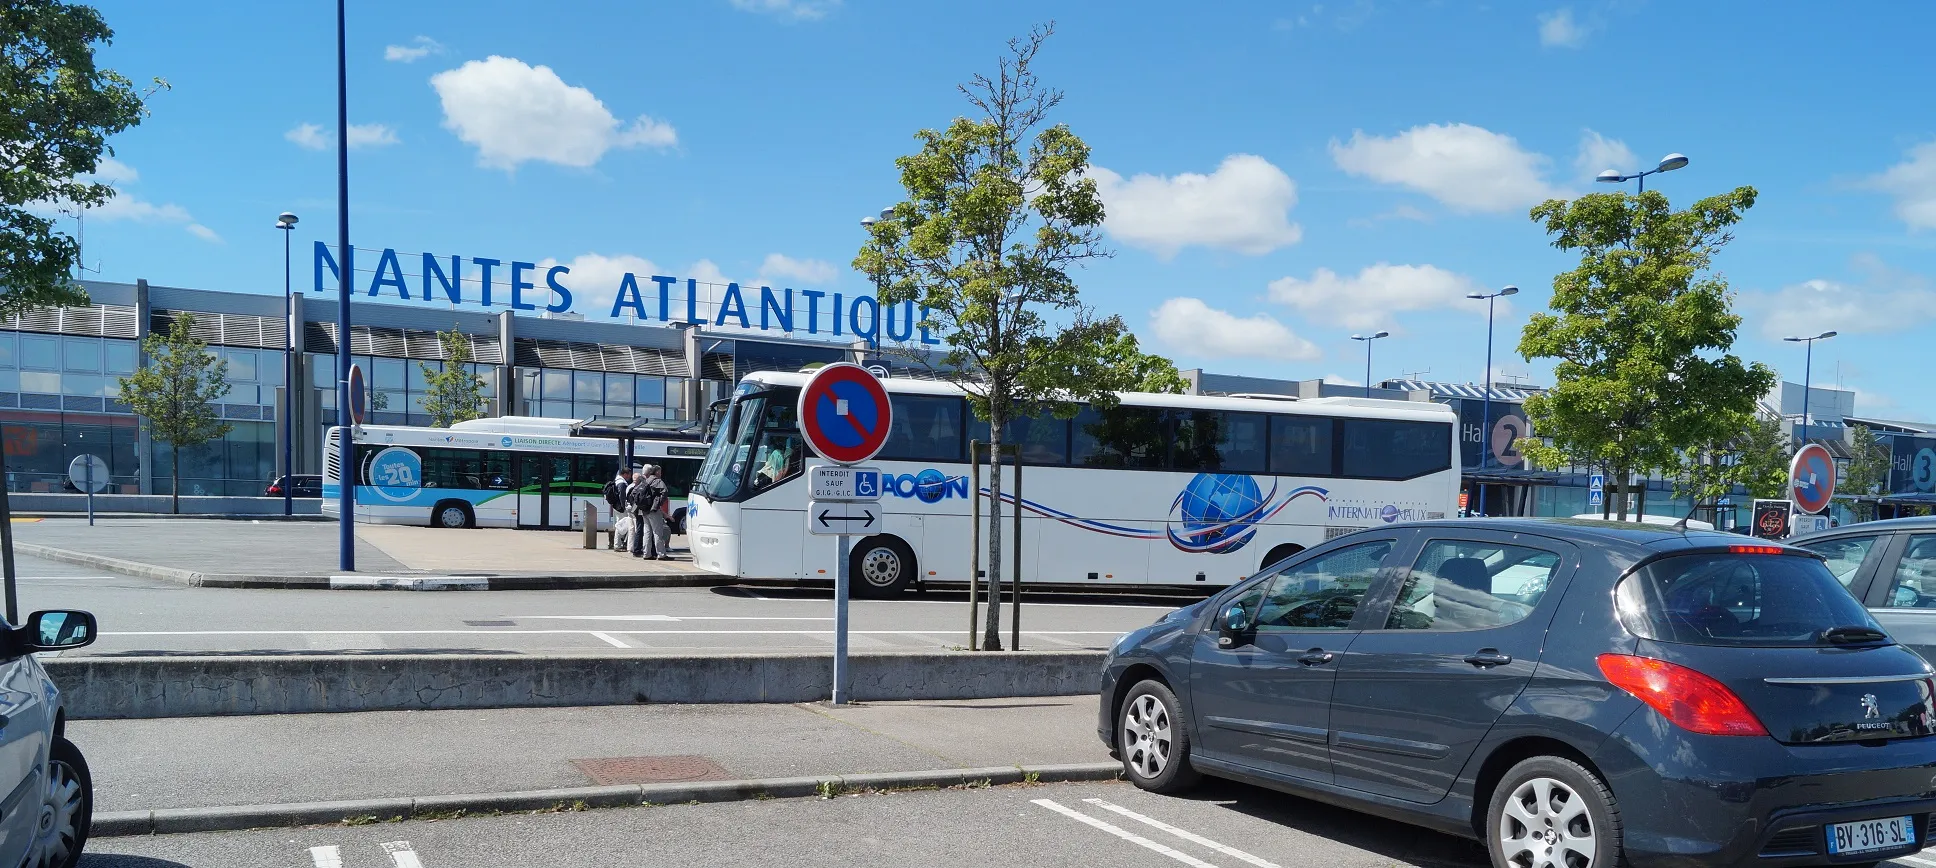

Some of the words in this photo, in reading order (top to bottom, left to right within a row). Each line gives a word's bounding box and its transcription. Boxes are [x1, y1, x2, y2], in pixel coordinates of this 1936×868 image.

[314, 241, 573, 313] NANTES
[1501, 423, 1518, 457] 2
[382, 462, 405, 470] Toutes
[384, 466, 413, 485] 20
[1893, 454, 1912, 471] Hall
[1918, 455, 1931, 483] 3
[1857, 722, 1891, 730] PEUGEOT
